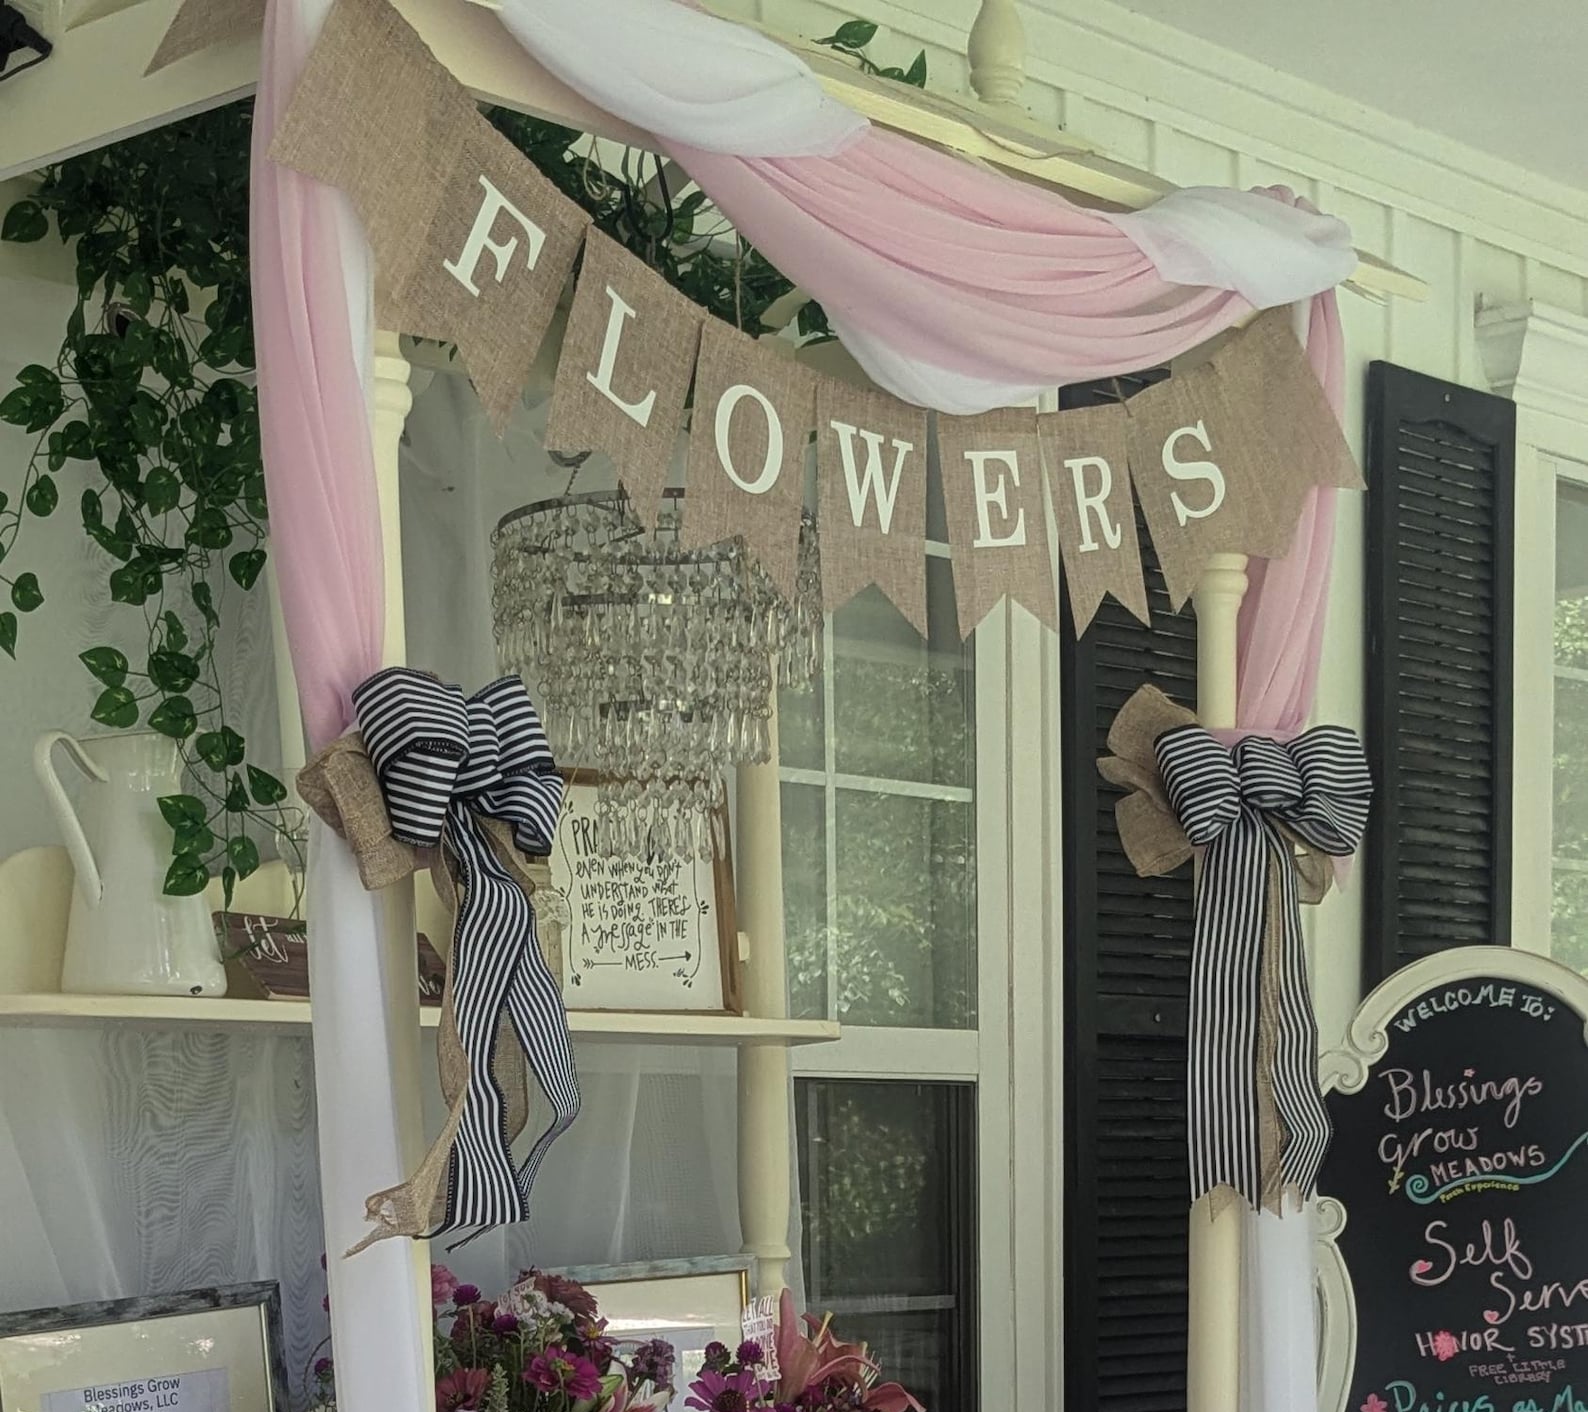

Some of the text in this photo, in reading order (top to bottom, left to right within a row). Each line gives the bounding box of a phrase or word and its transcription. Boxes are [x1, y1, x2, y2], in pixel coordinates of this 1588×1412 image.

[443, 174, 1226, 552] FLOWERS
[581, 881, 648, 906] UNDERSTAND
[582, 903, 594, 919] HE
[581, 922, 591, 945] A
[657, 921, 667, 942] IN
[670, 919, 688, 939] THE
[1394, 983, 1516, 1033] WELCOME
[1378, 1067, 1542, 1128] Blessings
[1430, 1145, 1545, 1186] MEADOWS
[1409, 1217, 1533, 1287] Self
[1469, 1363, 1507, 1378] FREE
[84, 1378, 180, 1403] Blessings Grow
[156, 1392, 179, 1409] LLC
